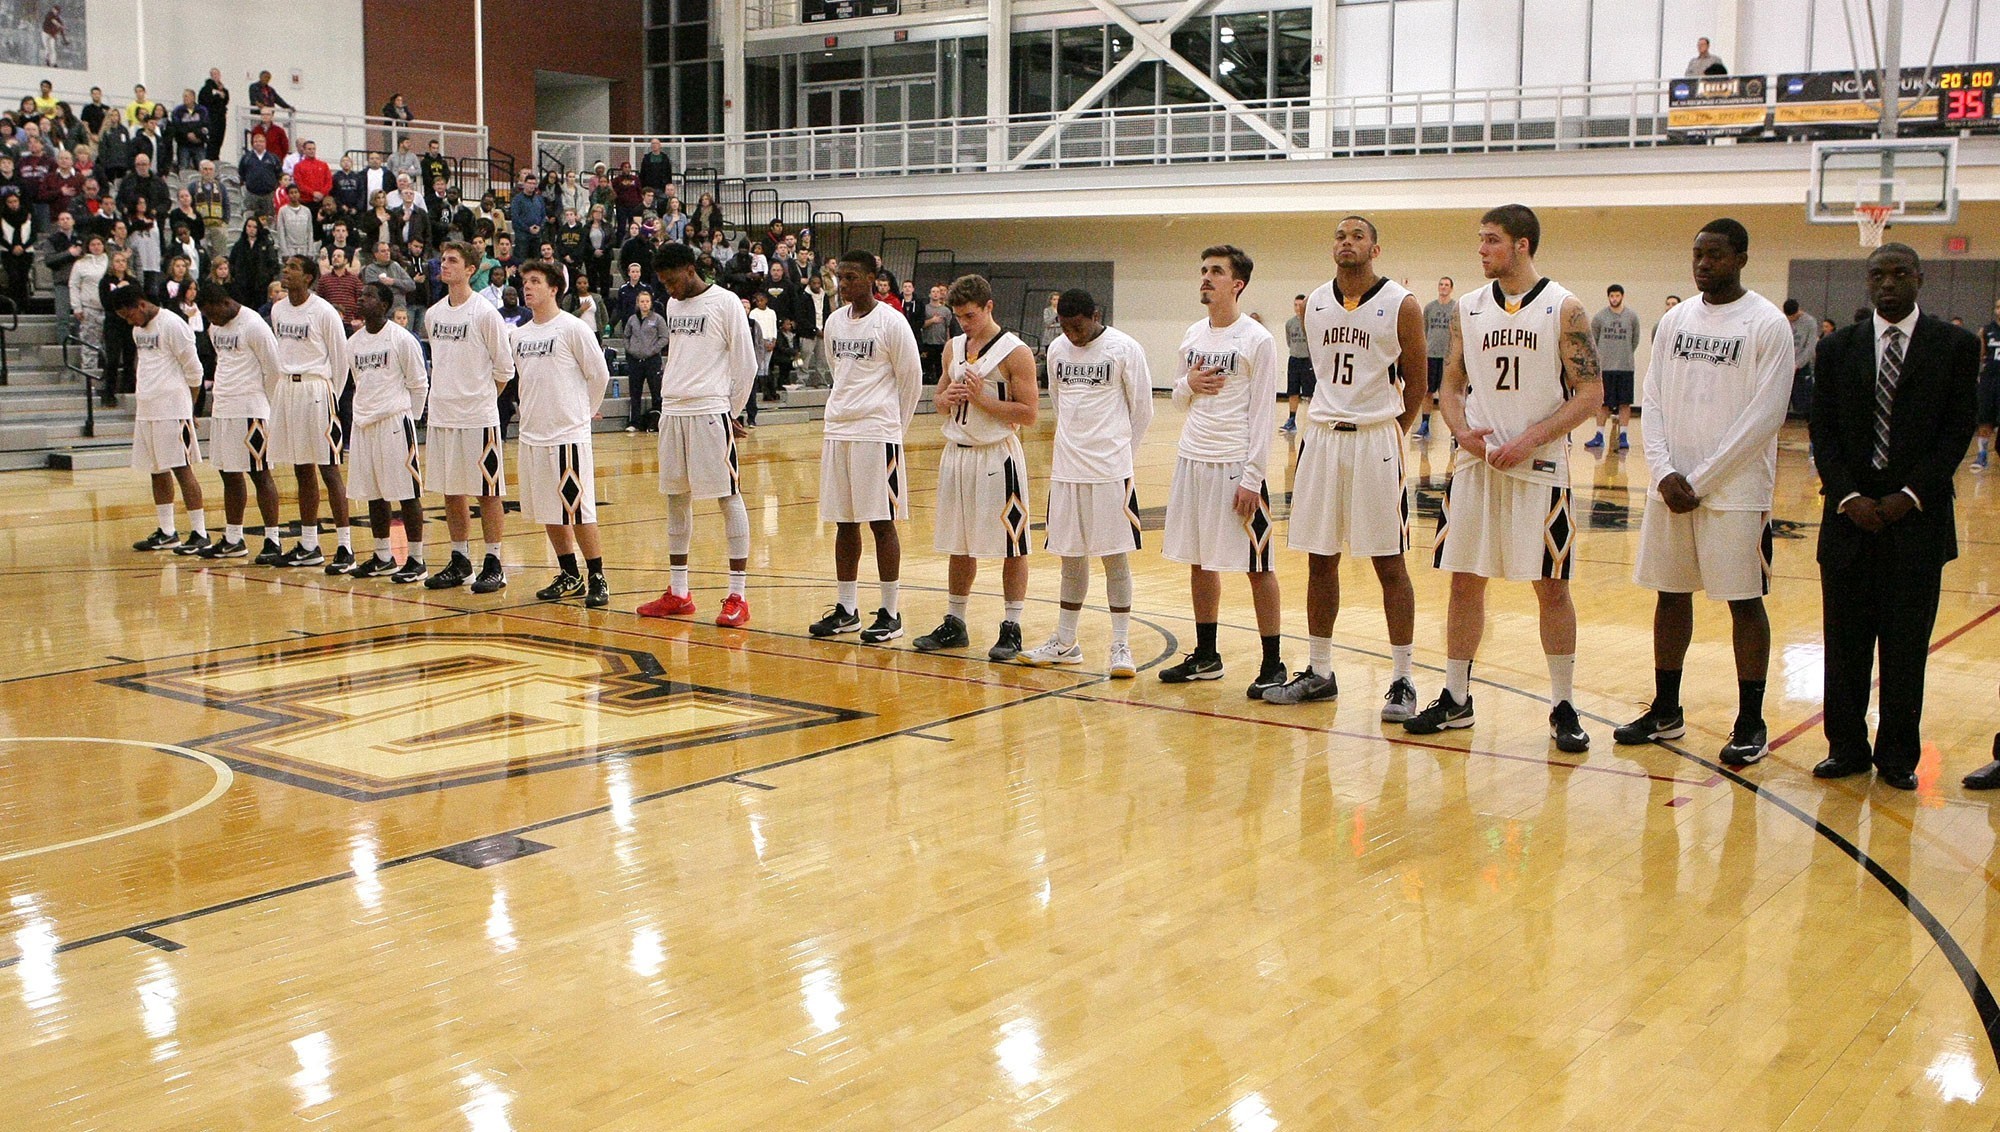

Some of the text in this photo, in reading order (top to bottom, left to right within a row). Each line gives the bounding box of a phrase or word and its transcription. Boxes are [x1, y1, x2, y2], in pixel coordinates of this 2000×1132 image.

[1947, 89, 1985, 119] 35
[669, 317, 705, 332] ADELPHI
[517, 339, 554, 356] ADELPHI
[832, 340, 873, 357] ADELPHI
[1323, 326, 1370, 351] ADELPHI
[1482, 328, 1537, 351] ADELPHI
[1674, 334, 1741, 361] ADELPHI
[1056, 362, 1110, 381] ADELPHI
[1332, 352, 1354, 386] 15
[1495, 356, 1520, 391] 21
